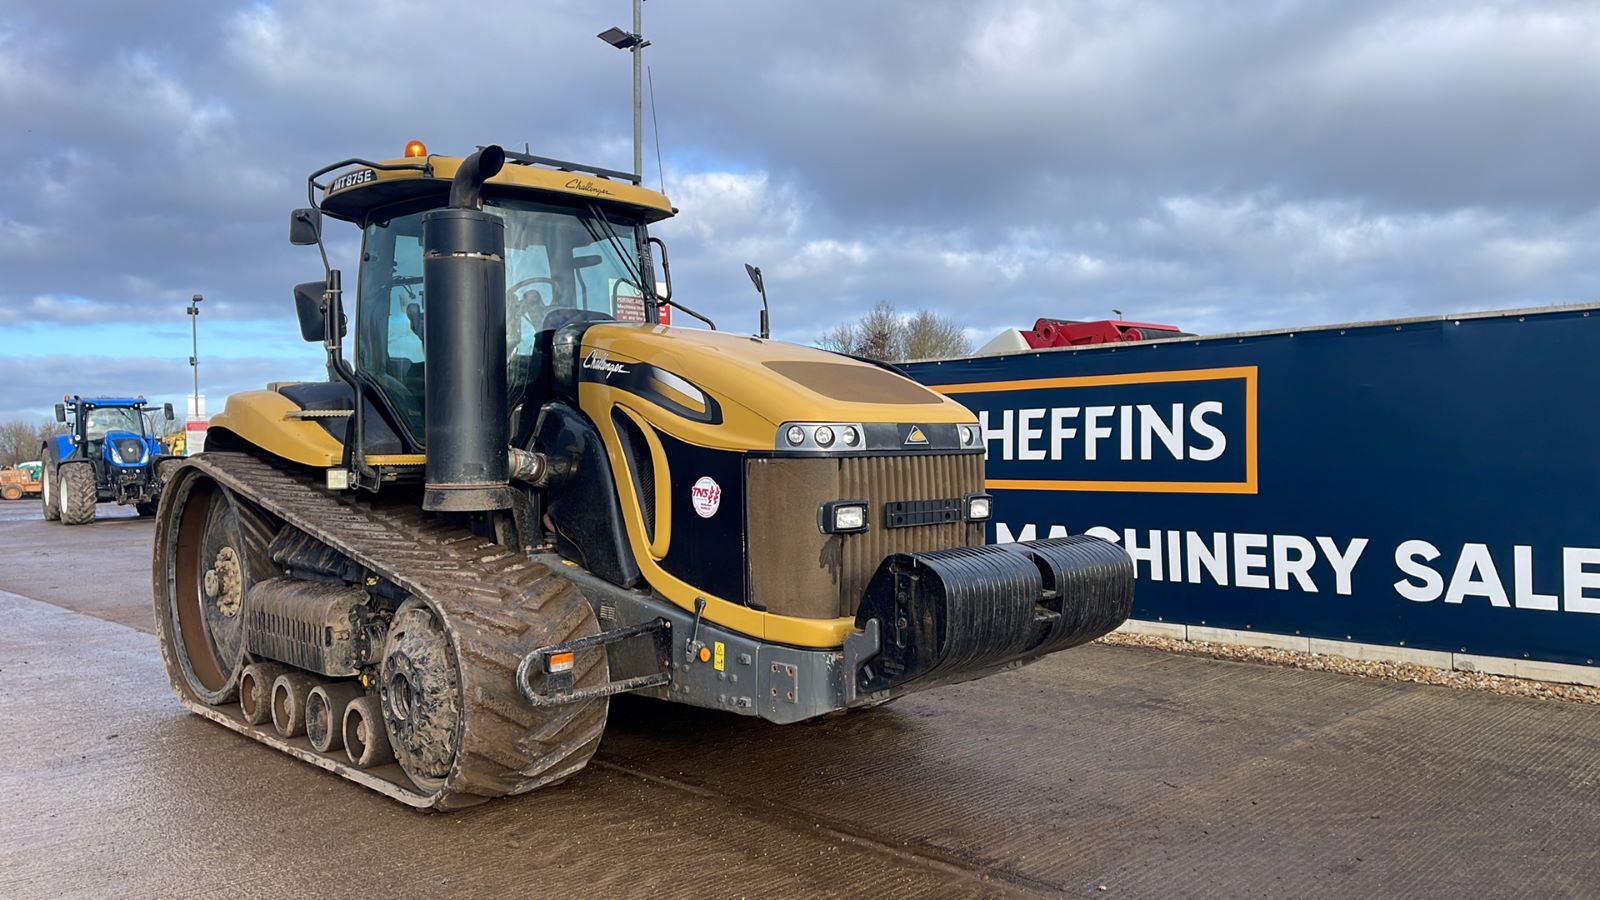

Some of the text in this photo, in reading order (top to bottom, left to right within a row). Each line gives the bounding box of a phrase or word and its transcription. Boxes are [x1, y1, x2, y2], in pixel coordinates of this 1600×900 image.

[333, 169, 372, 190] MT875E
[565, 178, 615, 196] Challenger
[583, 350, 630, 379] Challenger
[979, 401, 1227, 461] HEFFINS
[692, 488, 709, 497] TNS
[996, 522, 1600, 614] HINERY SALE
